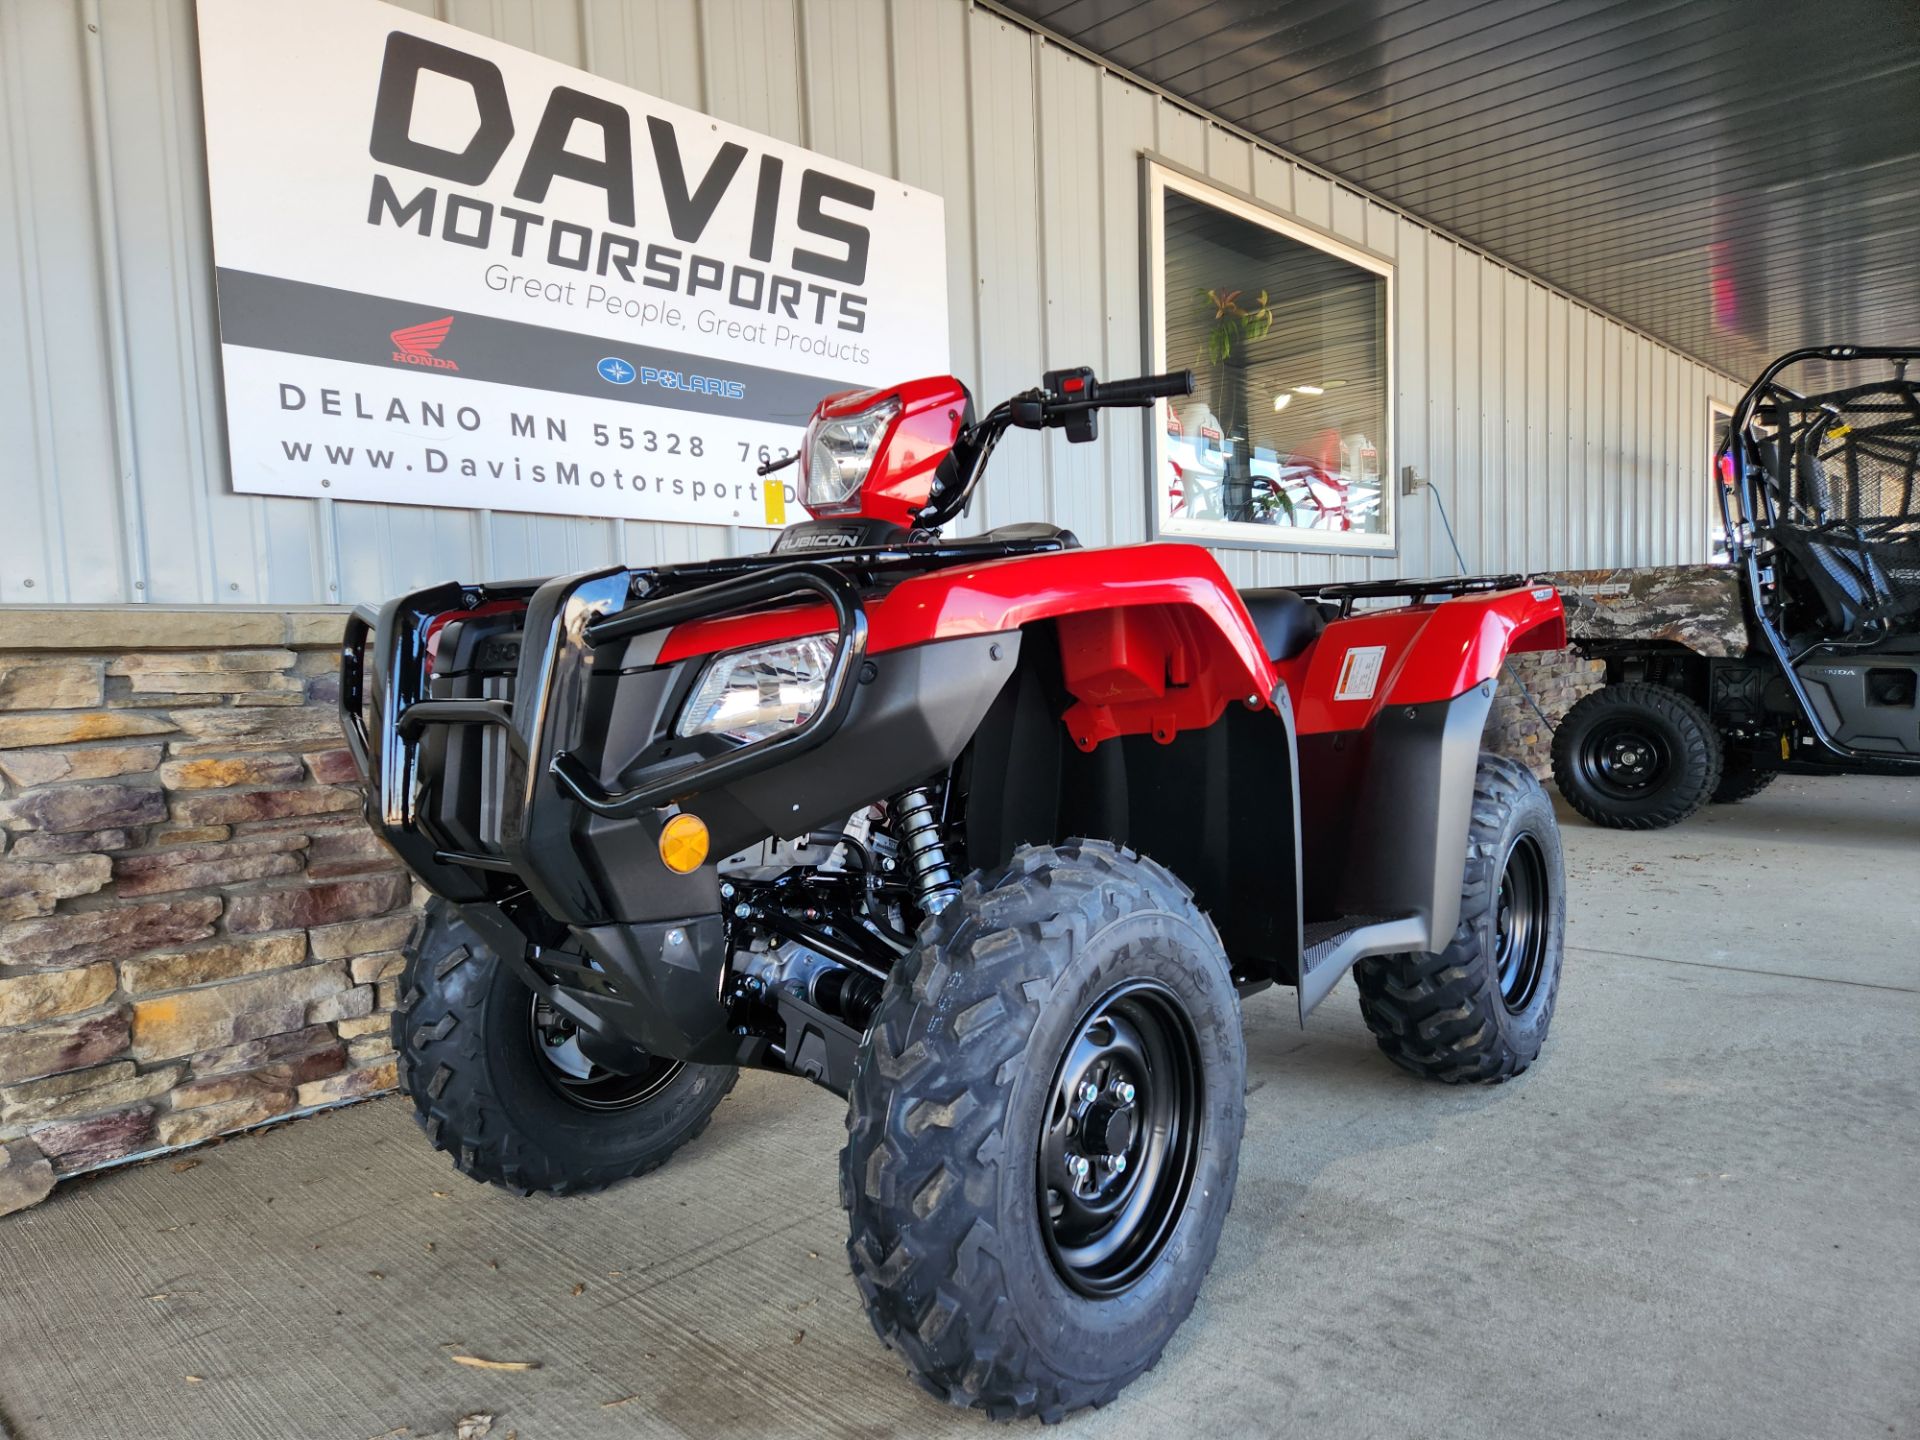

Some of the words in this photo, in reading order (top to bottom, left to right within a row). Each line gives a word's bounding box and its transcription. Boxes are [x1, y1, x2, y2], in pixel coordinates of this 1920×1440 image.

[369, 30, 876, 287] DAVIS
[367, 174, 868, 334] MOTORSPORTS
[485, 264, 576, 306] Great
[586, 284, 686, 332] People,
[697, 309, 767, 345] Great
[774, 325, 870, 365] Products
[392, 351, 460, 371] HONDA
[640, 366, 745, 399] POLARIS
[279, 383, 481, 431] DELANO
[510, 412, 567, 442] MN
[593, 423, 704, 457] 55328
[281, 440, 796, 503] www.DavisMotorsportD
[777, 534, 858, 551] RUBICON
